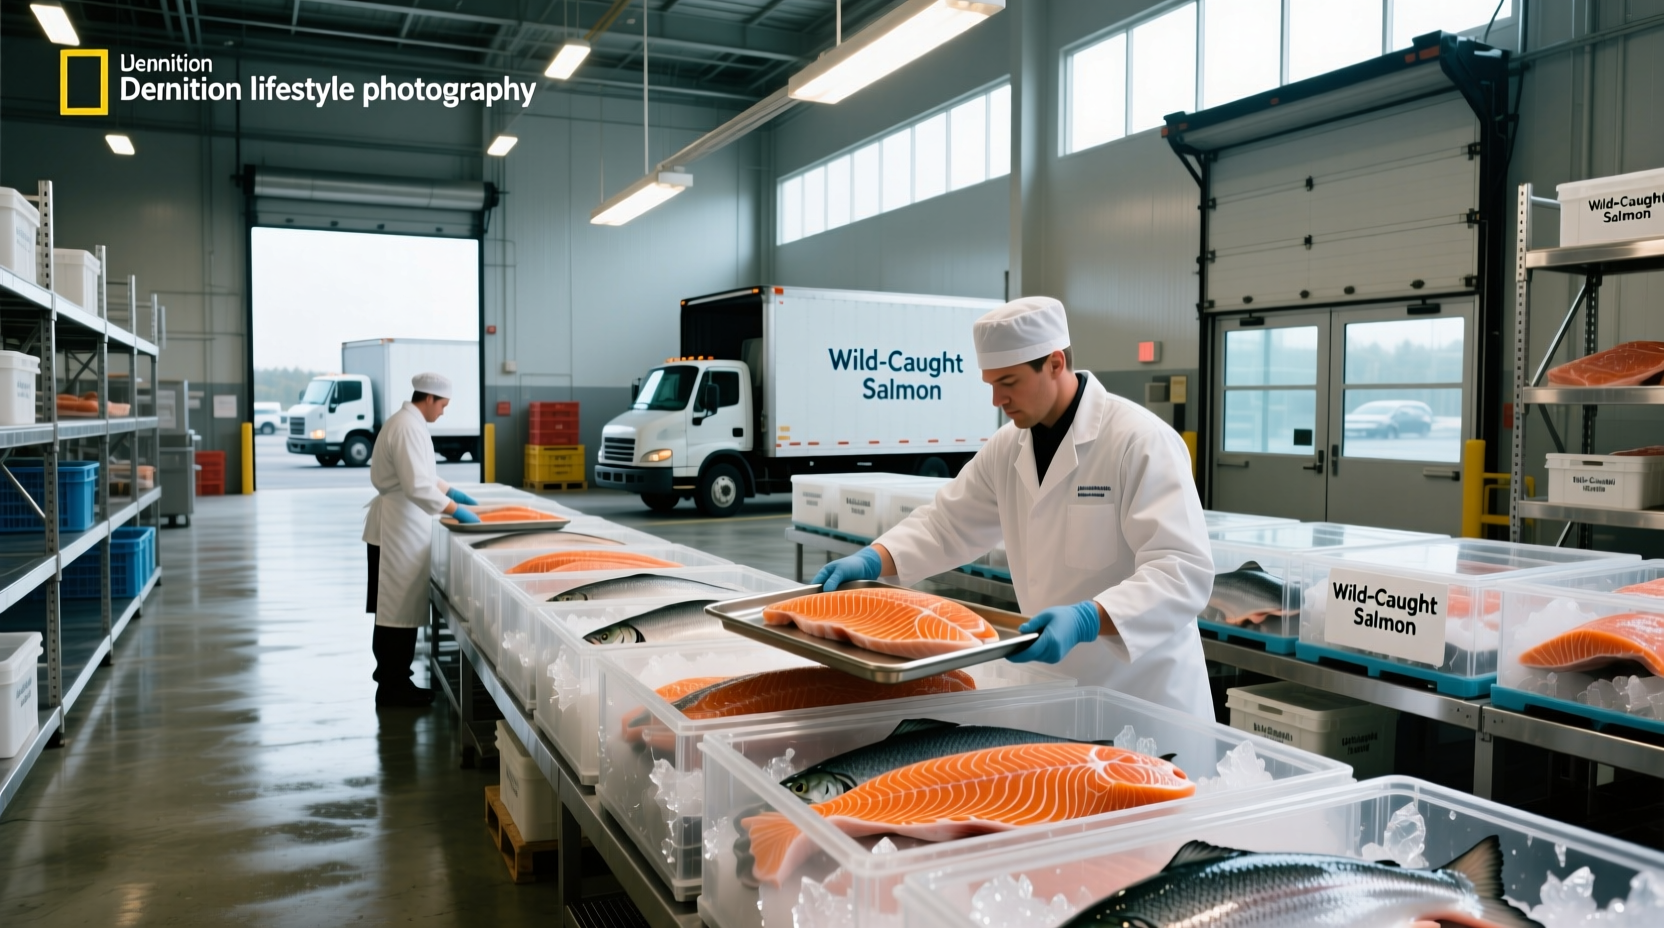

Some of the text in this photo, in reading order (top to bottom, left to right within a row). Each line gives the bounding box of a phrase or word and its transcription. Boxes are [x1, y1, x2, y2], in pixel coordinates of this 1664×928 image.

[1603, 209, 1651, 223] Salmon
[828, 348, 963, 378] Wild-Caught
[863, 377, 941, 400] Salmon
[1333, 582, 1438, 616] Wild-Caught
[1353, 607, 1416, 636] Salmon
